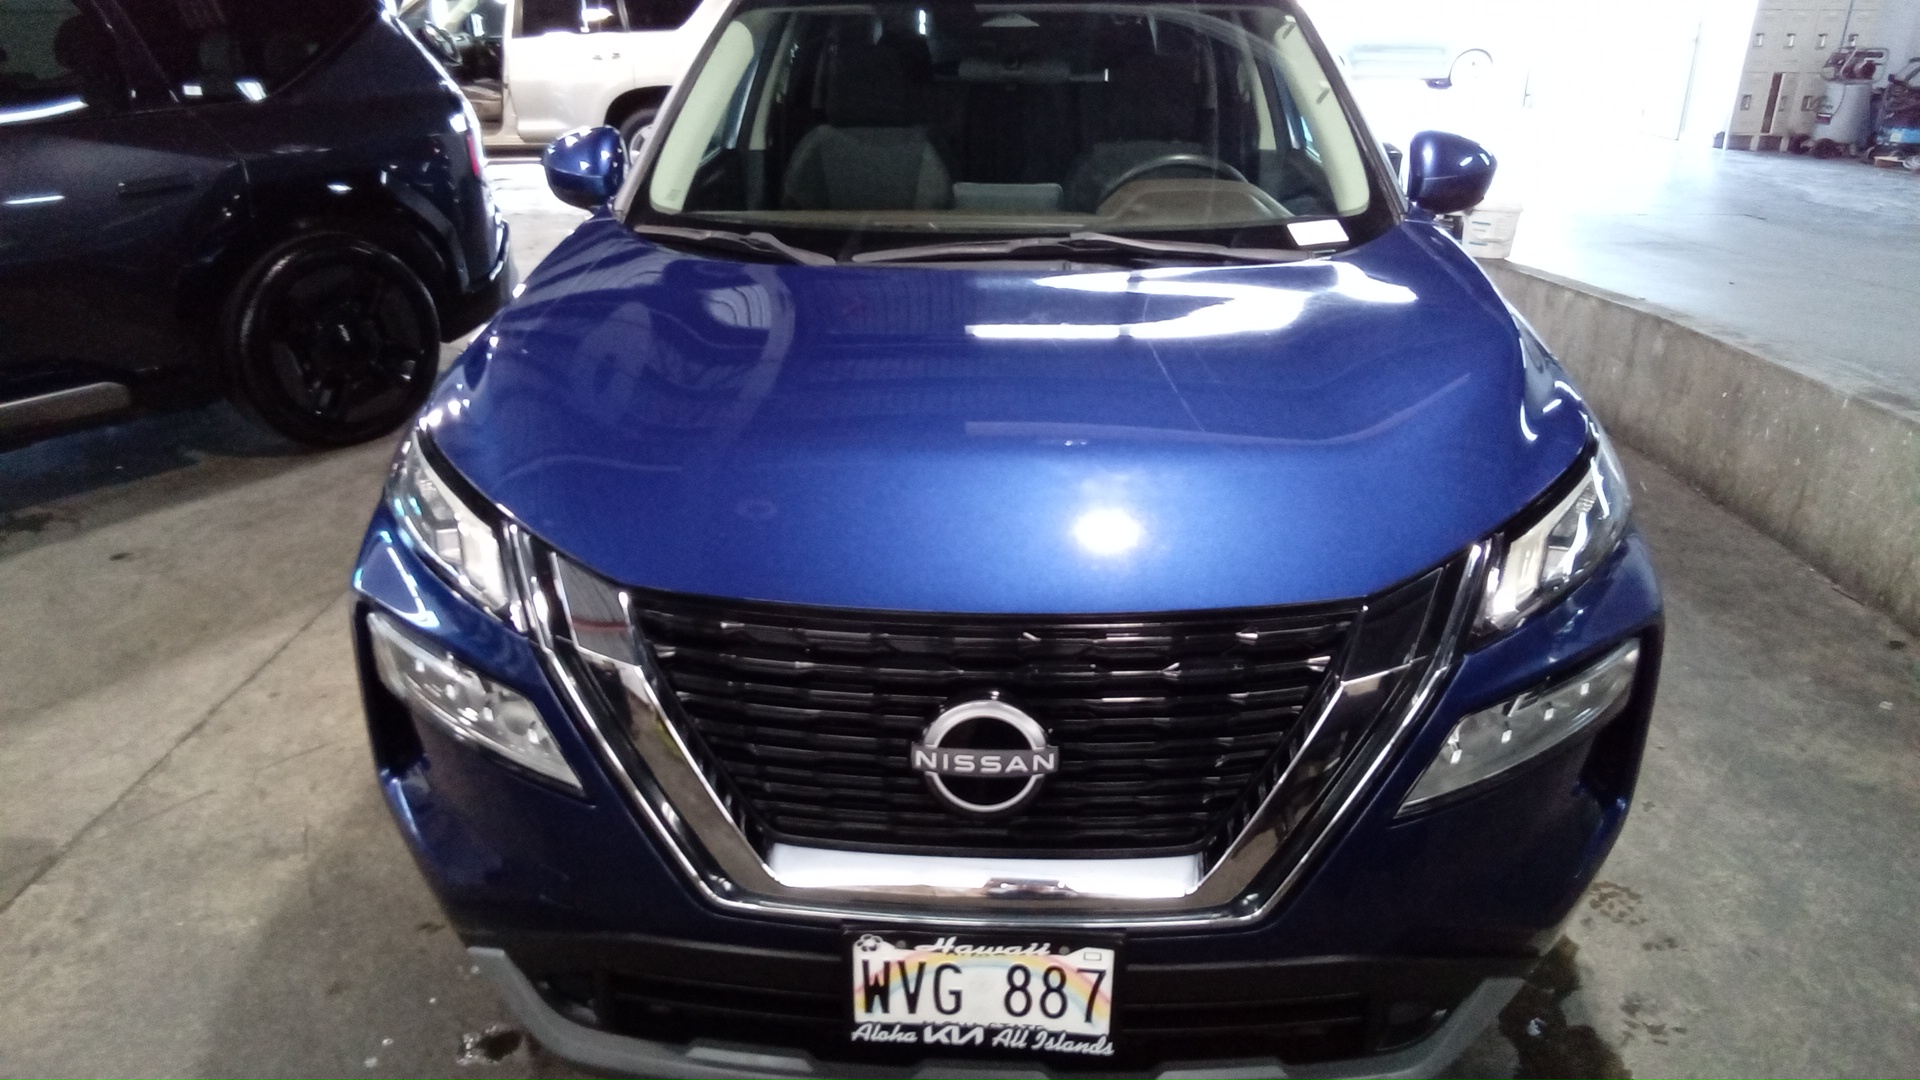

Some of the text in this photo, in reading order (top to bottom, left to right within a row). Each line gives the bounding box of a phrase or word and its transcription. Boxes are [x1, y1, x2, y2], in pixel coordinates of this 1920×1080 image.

[914, 750, 1055, 773] NISSAN
[914, 936, 1052, 956] Hawaii
[862, 959, 1107, 1024] WVG 887
[851, 1022, 918, 1043] Aloha
[991, 1027, 1028, 1048] All
[1030, 1030, 1115, 1056] Islands
